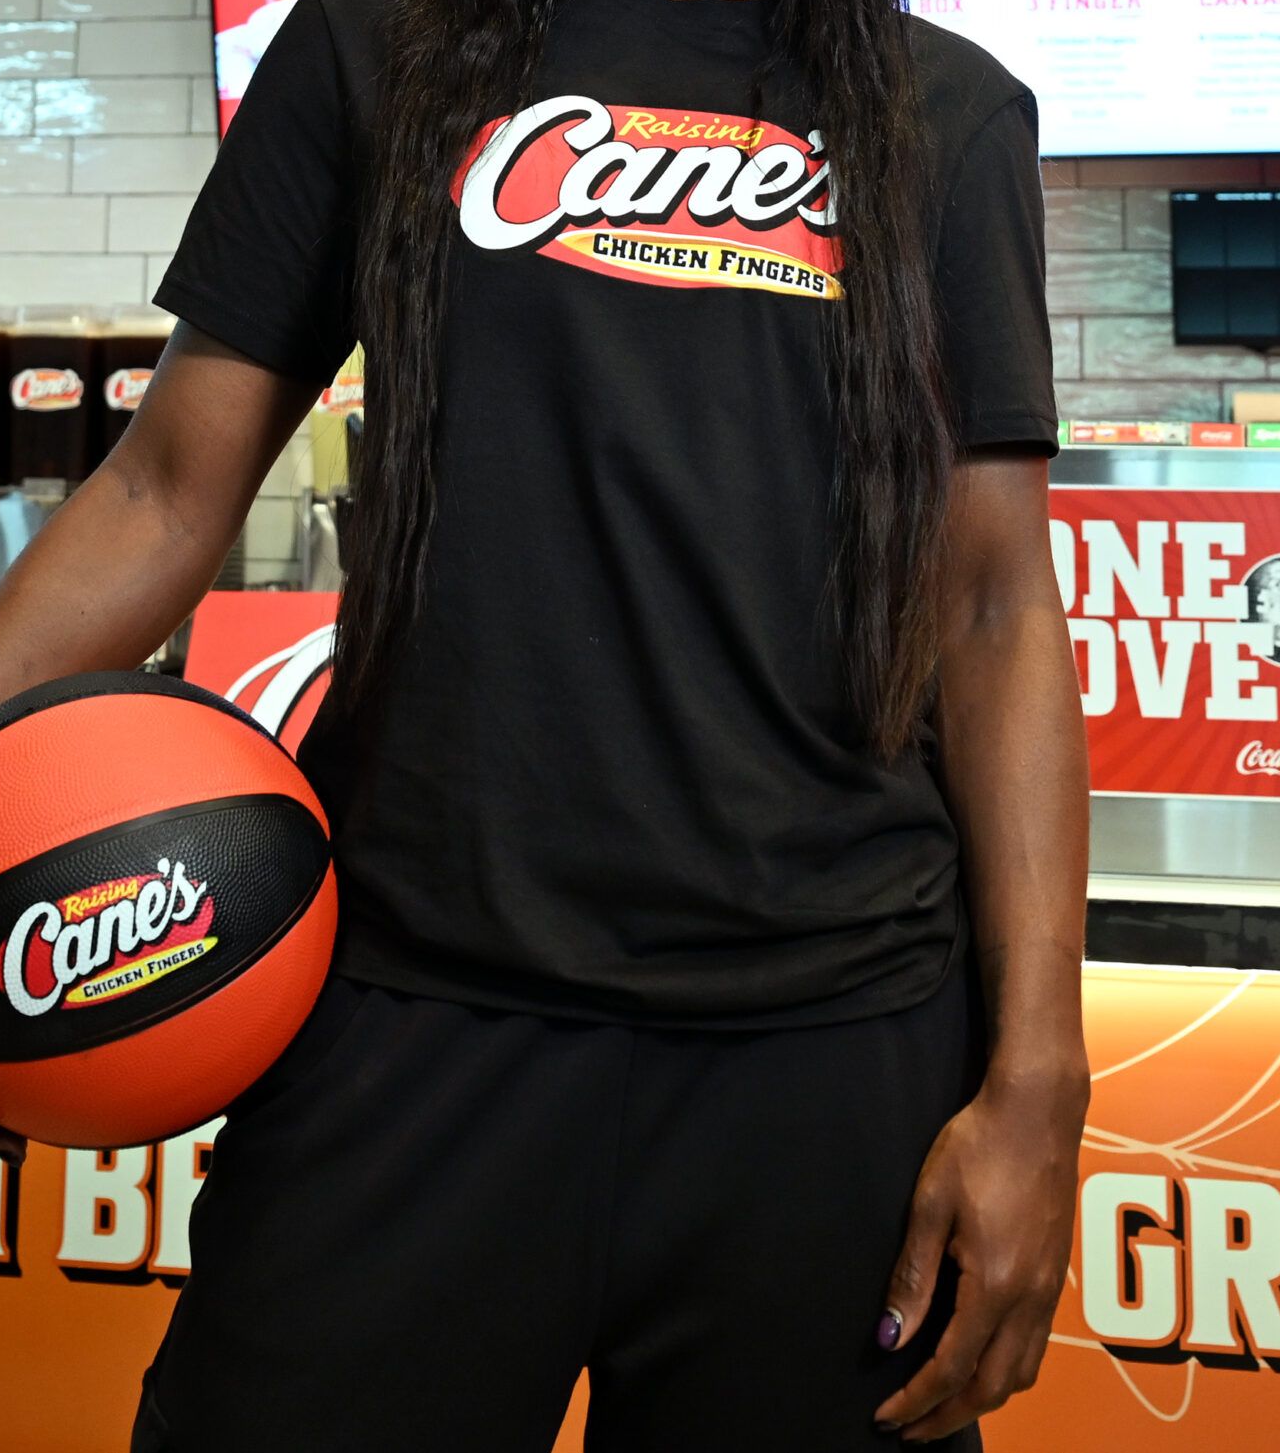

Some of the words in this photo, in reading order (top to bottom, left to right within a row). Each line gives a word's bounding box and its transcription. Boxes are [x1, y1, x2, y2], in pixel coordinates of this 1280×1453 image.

[618, 111, 764, 150] Raising
[593, 233, 709, 269] CHICKEN
[719, 250, 826, 294] FINGERS
[1066, 617, 1278, 722] OVE
[63, 879, 139, 922] Raising
[3, 857, 207, 1017] Cane's
[83, 968, 143, 998] CHICKEN
[147, 943, 205, 975] FINGERS
